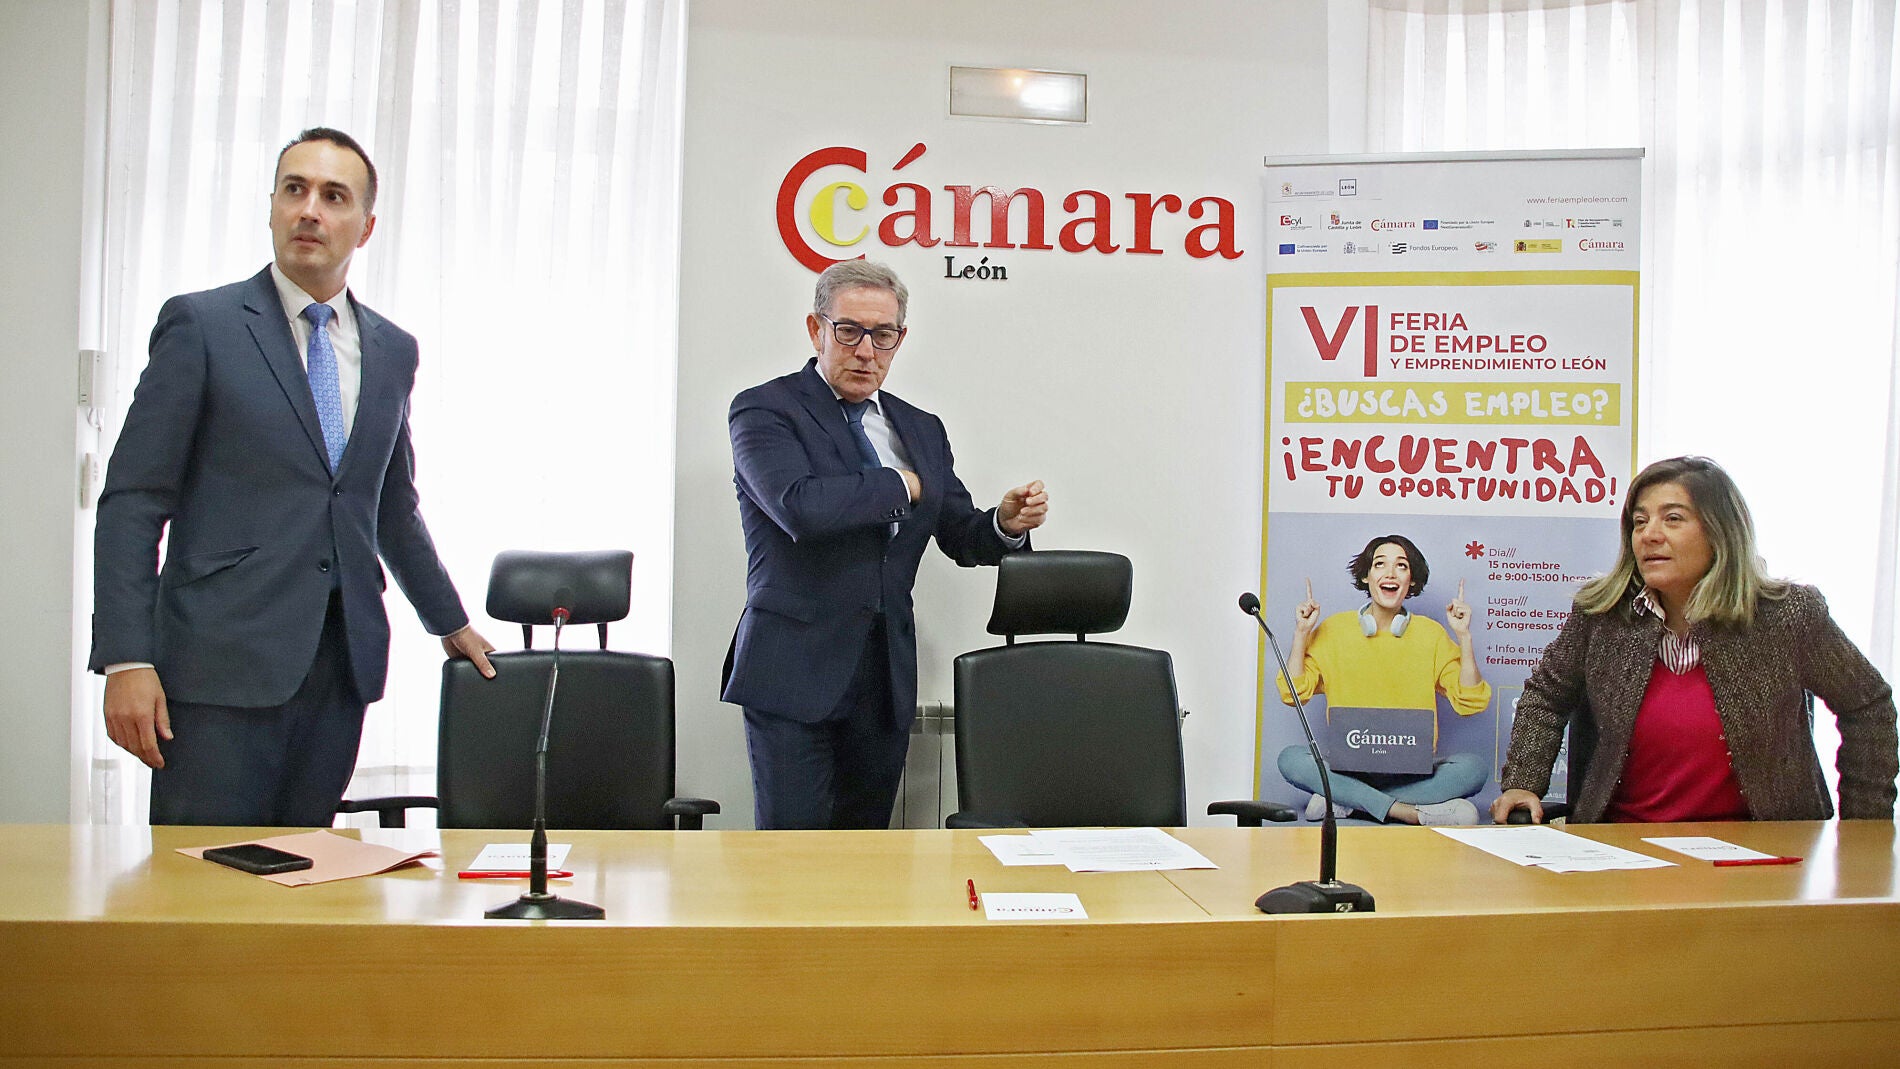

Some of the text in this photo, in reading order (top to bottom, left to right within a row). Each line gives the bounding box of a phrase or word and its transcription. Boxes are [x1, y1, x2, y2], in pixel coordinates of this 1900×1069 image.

[1527, 196, 1628, 205] www.feriaempleoleon.com
[945, 256, 1008, 281] León
[1390, 313, 1468, 331] FERIA
[1300, 305, 1379, 377] VI
[1390, 335, 1548, 354] DE EMPLEO
[1390, 355, 1607, 371] Y EMPRENDIMIENTO LEÓN
[1298, 388, 1609, 421] ¿BUSCAS EMPLEO?
[1282, 435, 1606, 481] ¡ENCUENTRA
[1326, 475, 1617, 506] TU OPORTUNIDAD!
[1488, 560, 1561, 570] 15 noviembre
[1488, 572, 1502, 581] de
[1505, 573, 1559, 582] 9:00-15:00
[1488, 608, 1527, 617] Palacio
[1530, 609, 1544, 618] de
[1487, 622, 1493, 630] y
[1496, 620, 1554, 631] Congresos
[1495, 644, 1516, 653] Info
[1528, 645, 1543, 654] Ins
